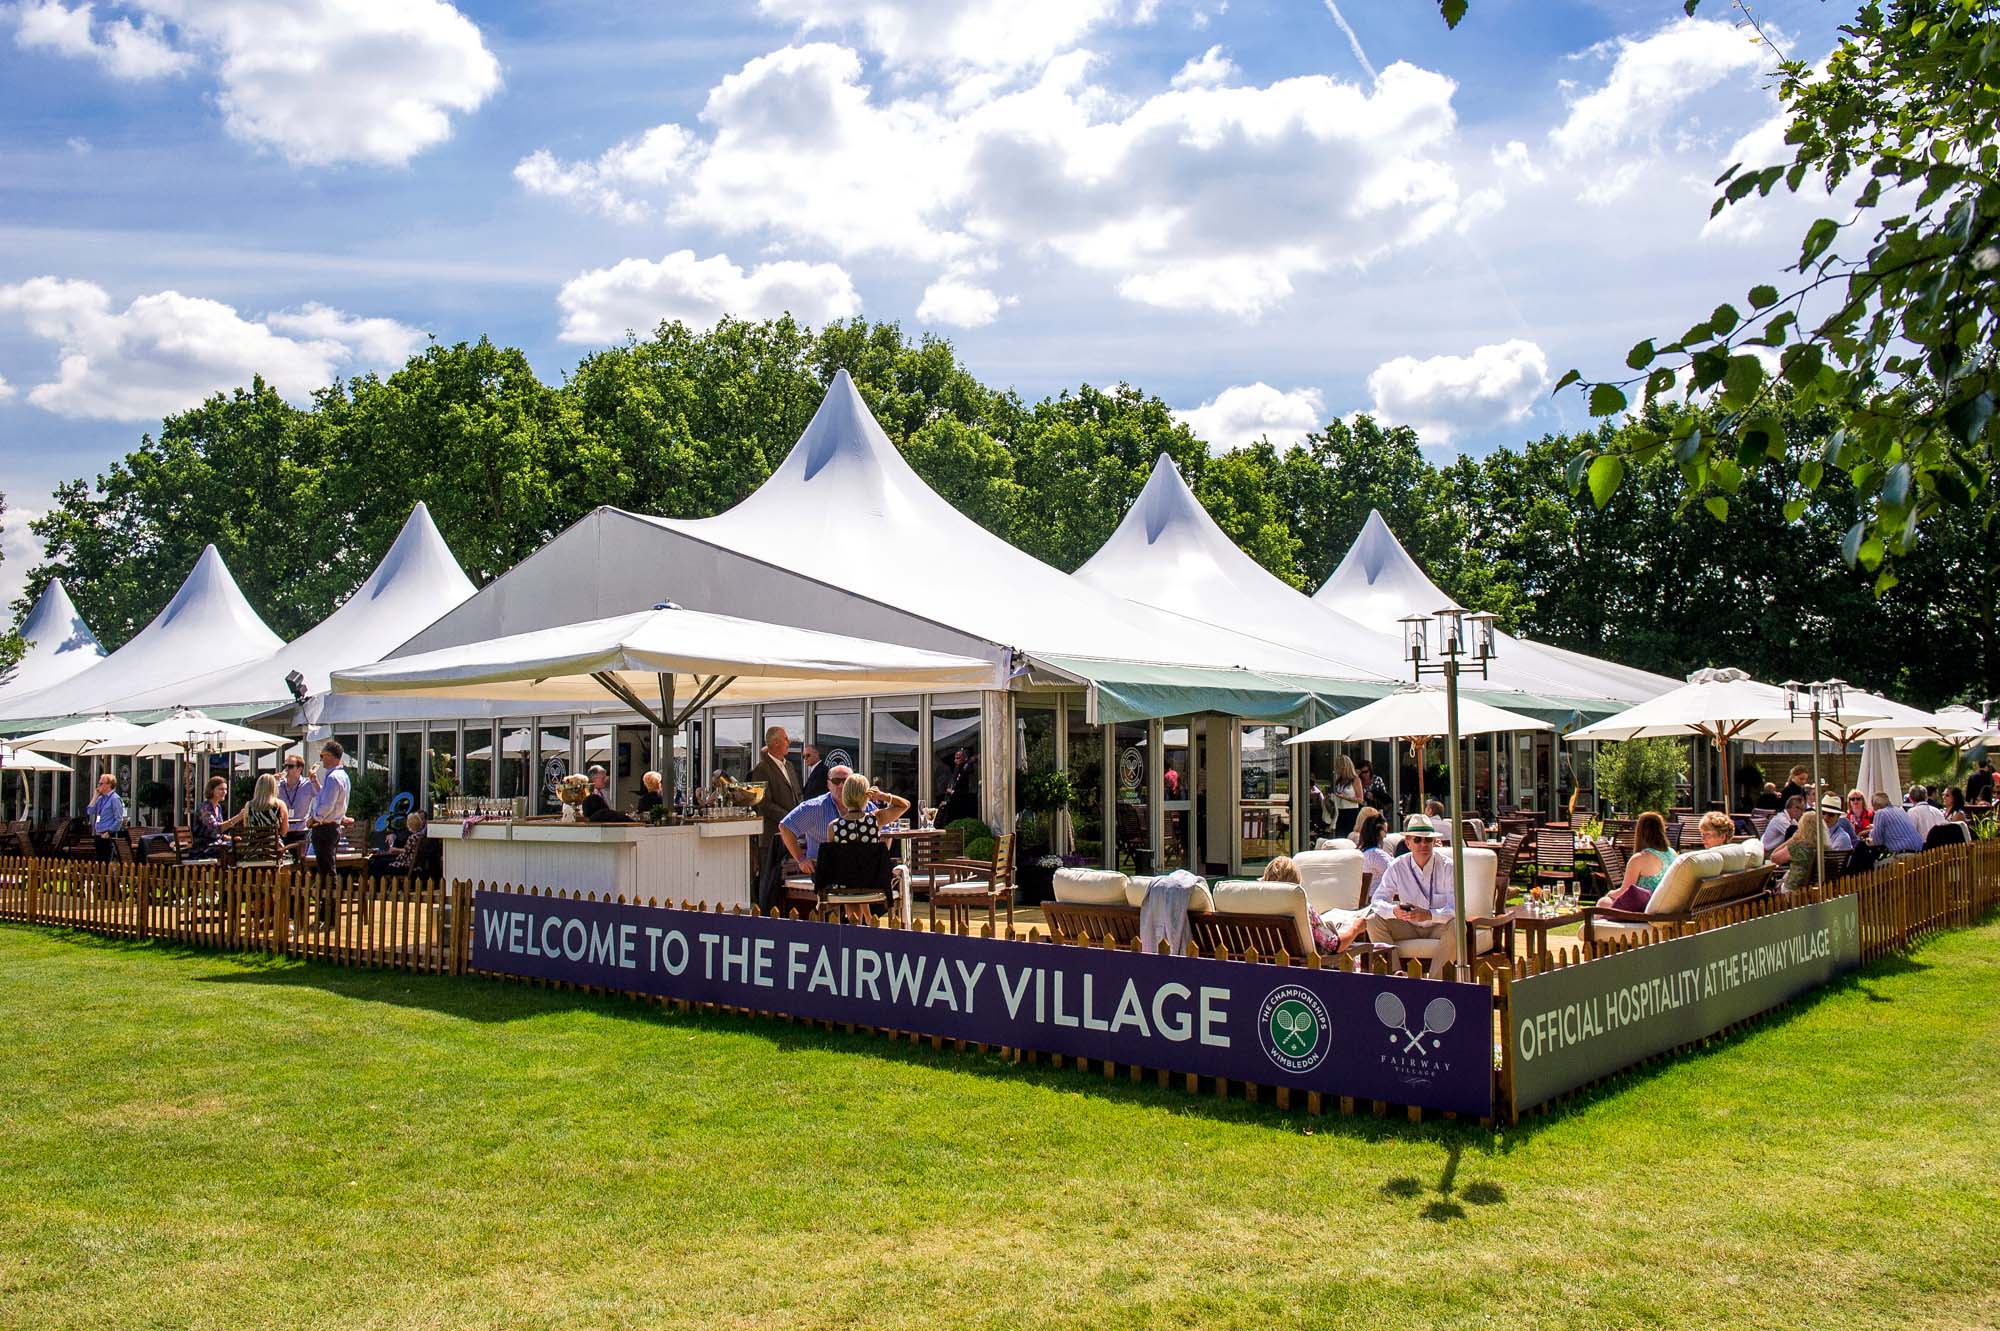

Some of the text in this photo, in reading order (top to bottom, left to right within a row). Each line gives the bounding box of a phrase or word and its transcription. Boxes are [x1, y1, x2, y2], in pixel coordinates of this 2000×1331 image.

[482, 908, 1231, 1048] WELCOME TO THE FAIRWAY VILLAGE
[1262, 989, 1327, 1030] THE CHAMPIONSHIPS
[1519, 997, 1603, 1061] OFFICIAL
[1606, 967, 1701, 1031] HOSPITALITY
[1704, 960, 1719, 1000] AT
[1718, 954, 1740, 992] THE
[1741, 939, 1789, 982] FAIRWAY
[1788, 928, 1831, 966] VILLAGE
[1270, 1046, 1320, 1069] WIMBLEDON
[1380, 1055, 1450, 1071] FAIRWAY
[1394, 1066, 1435, 1077] VILLAGE
